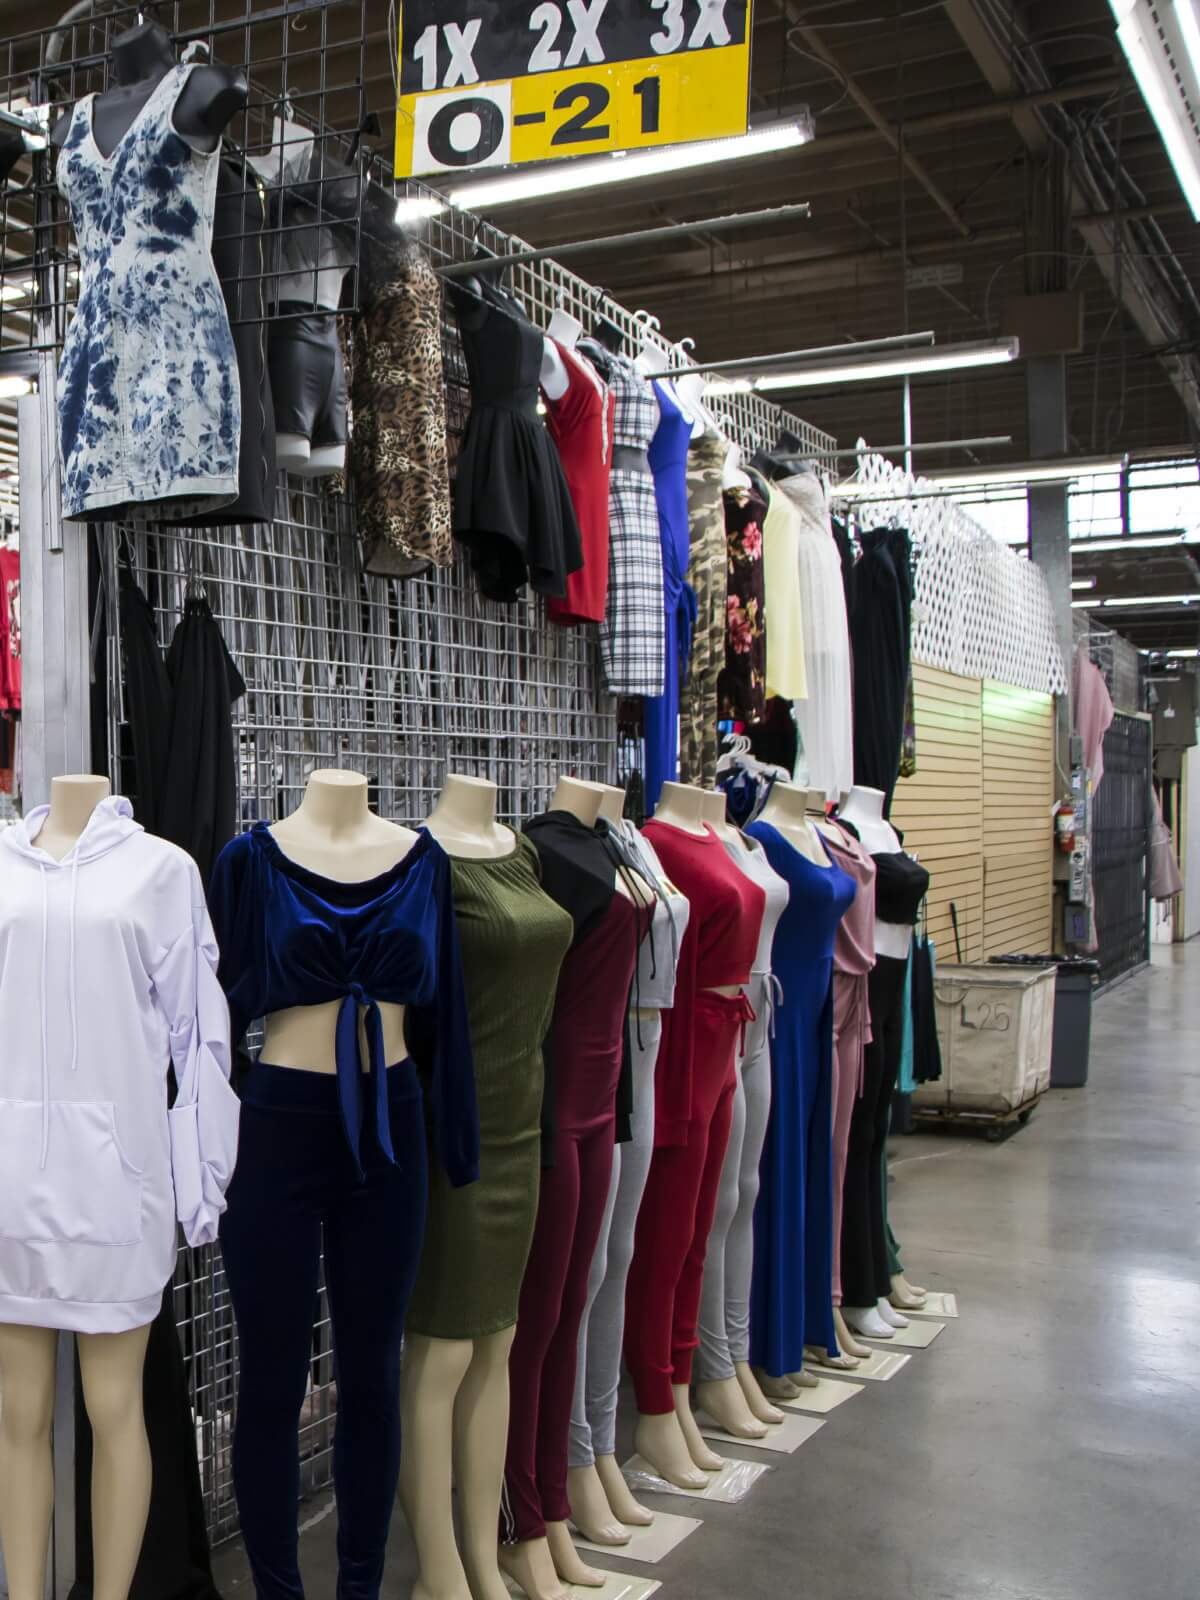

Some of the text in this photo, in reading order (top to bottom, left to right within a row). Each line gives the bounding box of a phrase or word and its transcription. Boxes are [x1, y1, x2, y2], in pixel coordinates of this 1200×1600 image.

[413, 0, 731, 90] 1X 2X 3X
[960, 1002, 1009, 1032] L25
